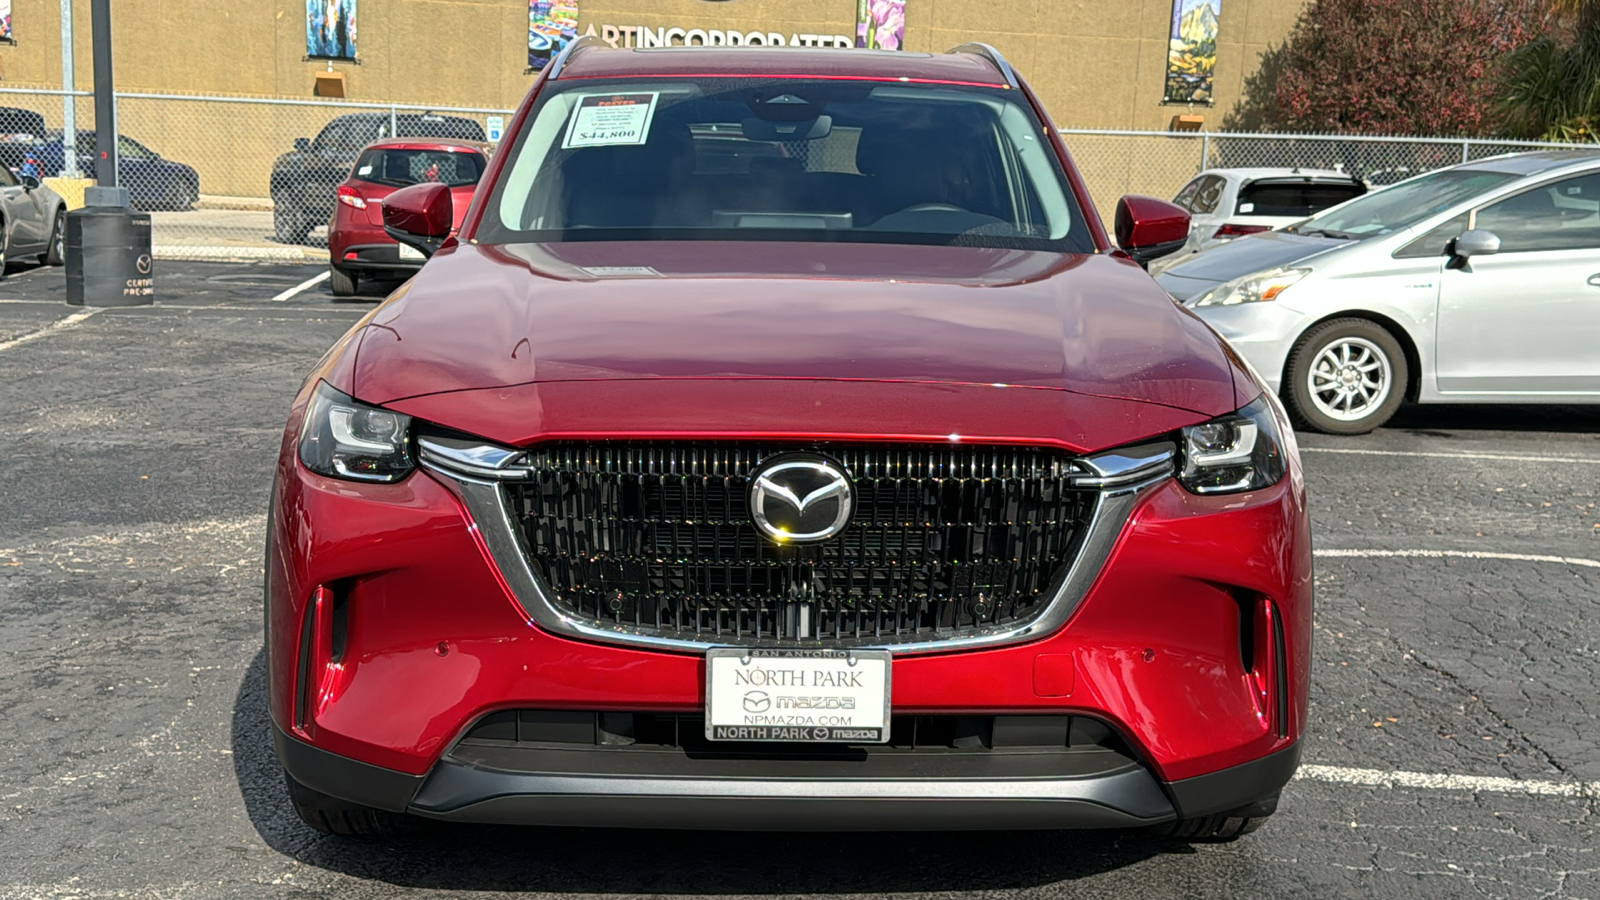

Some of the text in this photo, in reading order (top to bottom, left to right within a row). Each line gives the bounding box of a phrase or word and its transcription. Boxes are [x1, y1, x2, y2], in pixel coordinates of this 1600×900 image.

[579, 130, 635, 140] $44,800
[734, 667, 864, 687] NORTH PARK
[776, 695, 856, 710] mazda
[744, 715, 852, 726] NPMAZDA.COM
[717, 727, 878, 739] NORTH PARK mazda
